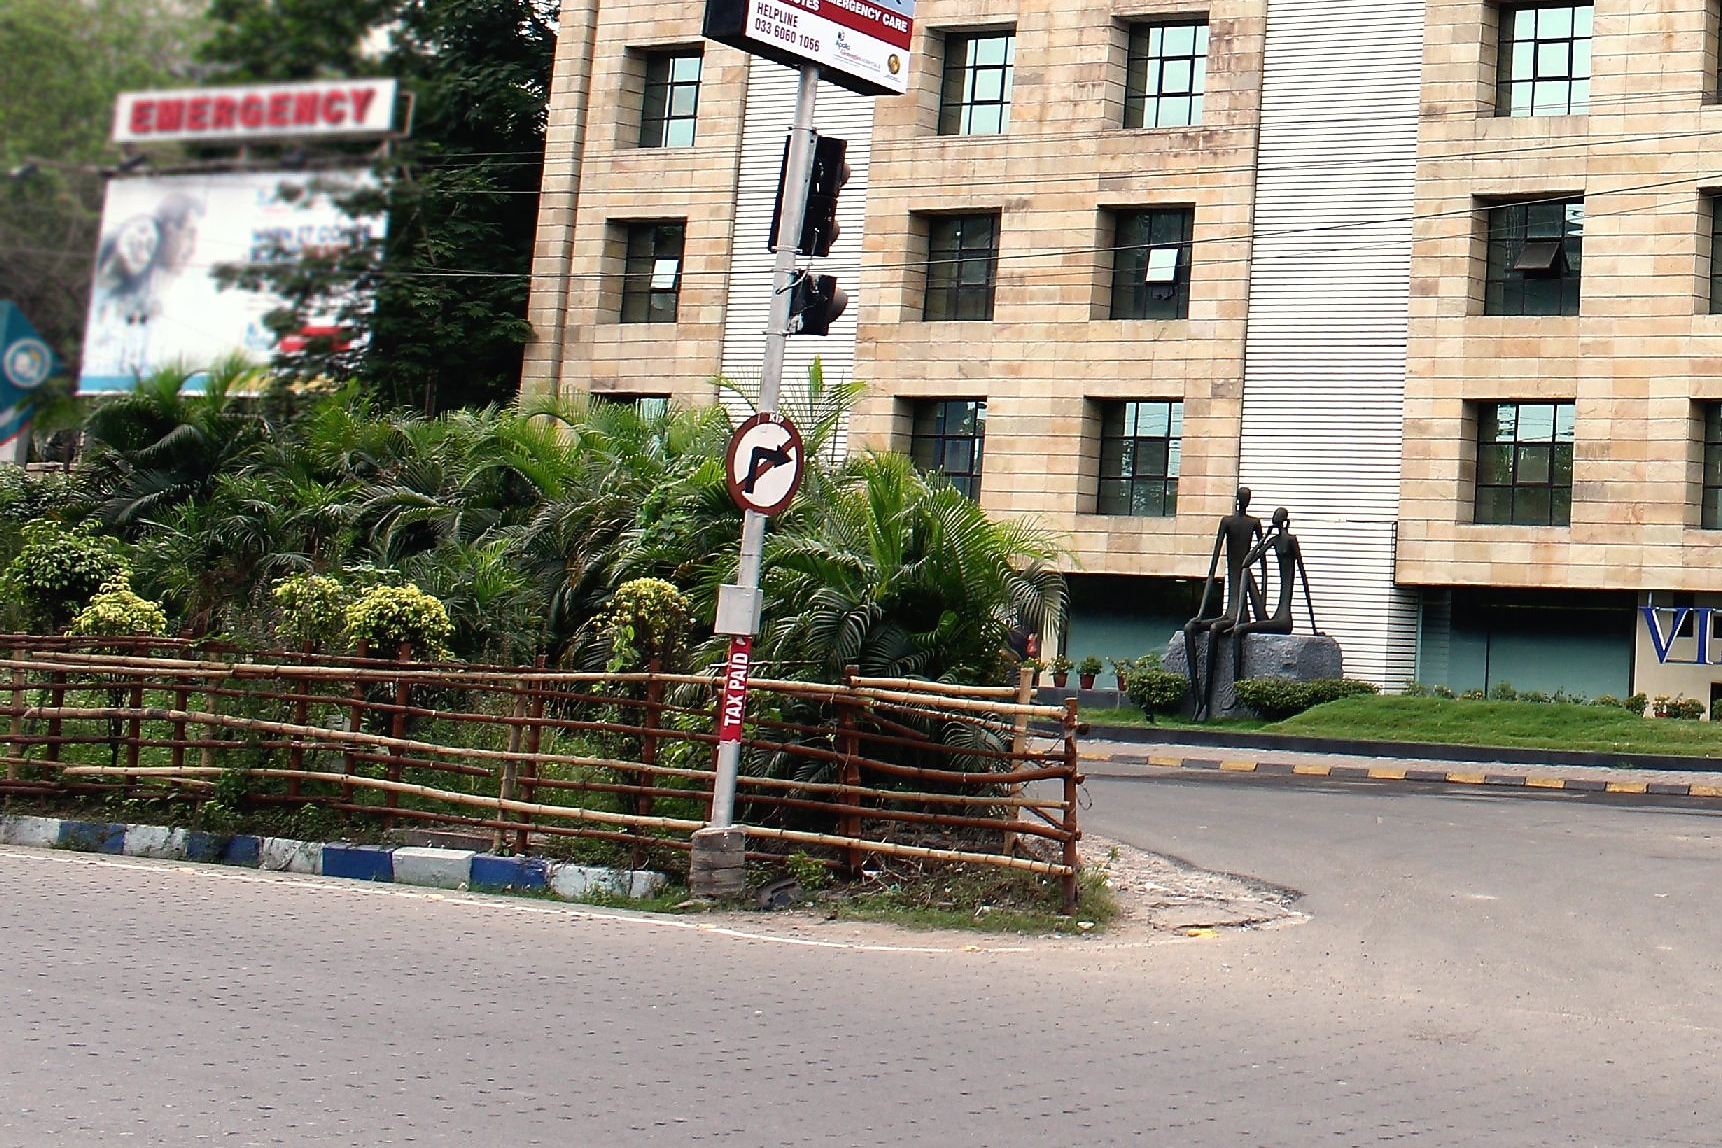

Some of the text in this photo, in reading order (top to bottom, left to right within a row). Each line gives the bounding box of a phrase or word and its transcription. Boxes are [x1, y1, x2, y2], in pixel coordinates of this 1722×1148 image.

[755, 18, 771, 35] 033
[757, 2, 798, 27] HELPLINE
[882, 14, 908, 32] CARE
[129, 88, 377, 134] EMERGENCY
[724, 653, 748, 727] TAX PAID
